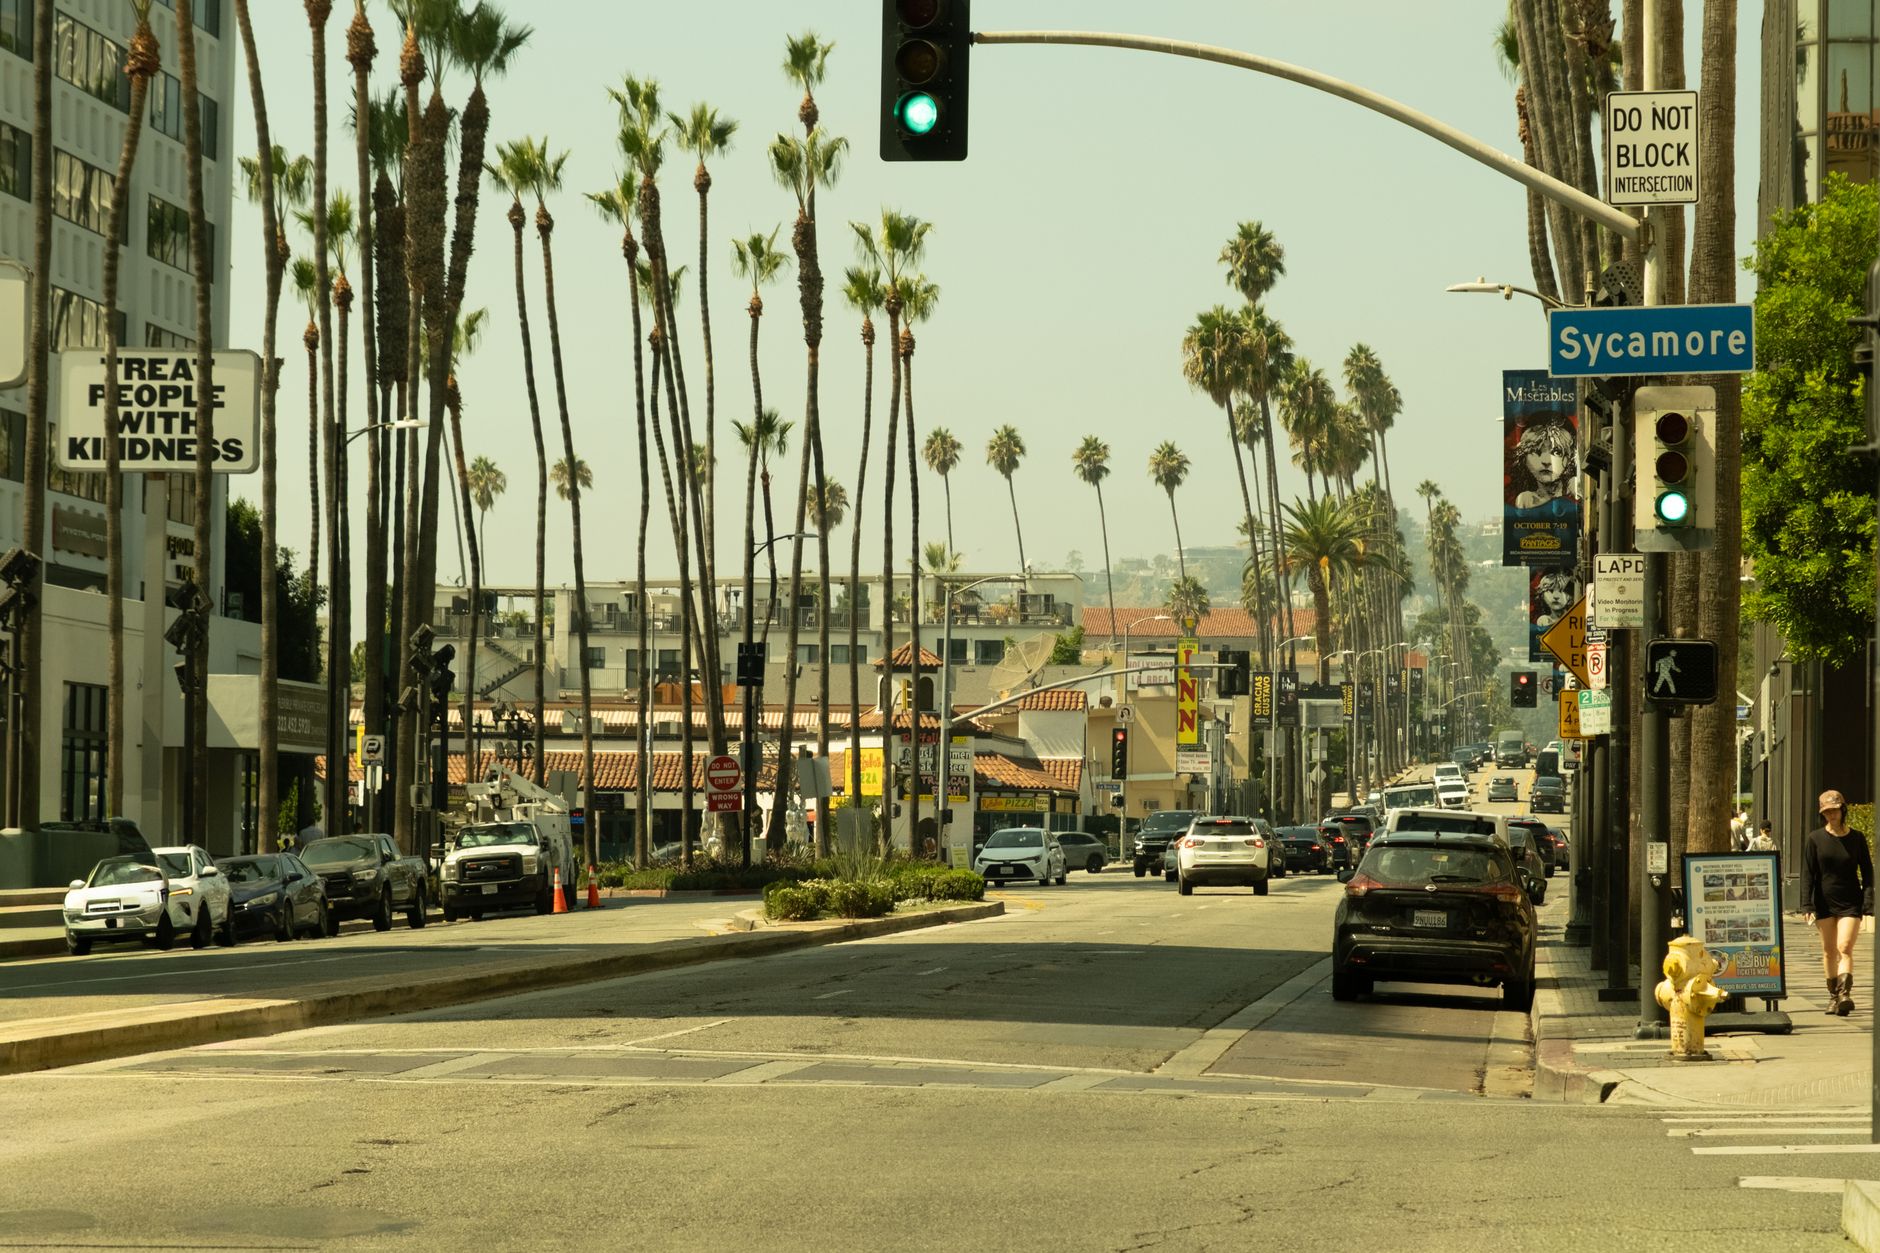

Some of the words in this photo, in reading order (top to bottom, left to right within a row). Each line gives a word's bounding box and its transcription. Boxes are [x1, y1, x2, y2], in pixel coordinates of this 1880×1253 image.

[1613, 107, 1642, 132] DO
[1652, 105, 1693, 131] NOT
[1616, 142, 1690, 168] BLOCK
[1615, 175, 1693, 193] INTERSECTION
[1559, 326, 1746, 367] Sycamore
[1531, 380, 1547, 392] Les
[1520, 539, 1560, 547] PANTAGES
[1598, 560, 1644, 573] LAPD
[1178, 650, 1197, 733] INN
[1254, 676, 1262, 716] GRACIAS
[1263, 676, 1271, 716] GUSTAVO
[1581, 692, 1589, 703] 2
[950, 751, 971, 760] men
[861, 772, 878, 785] ZZA
[921, 776, 968, 786] TRCAL
[1004, 799, 1034, 808] PIZZA
[1754, 955, 1771, 968] BUY
[1737, 968, 1756, 976] TICKETS
